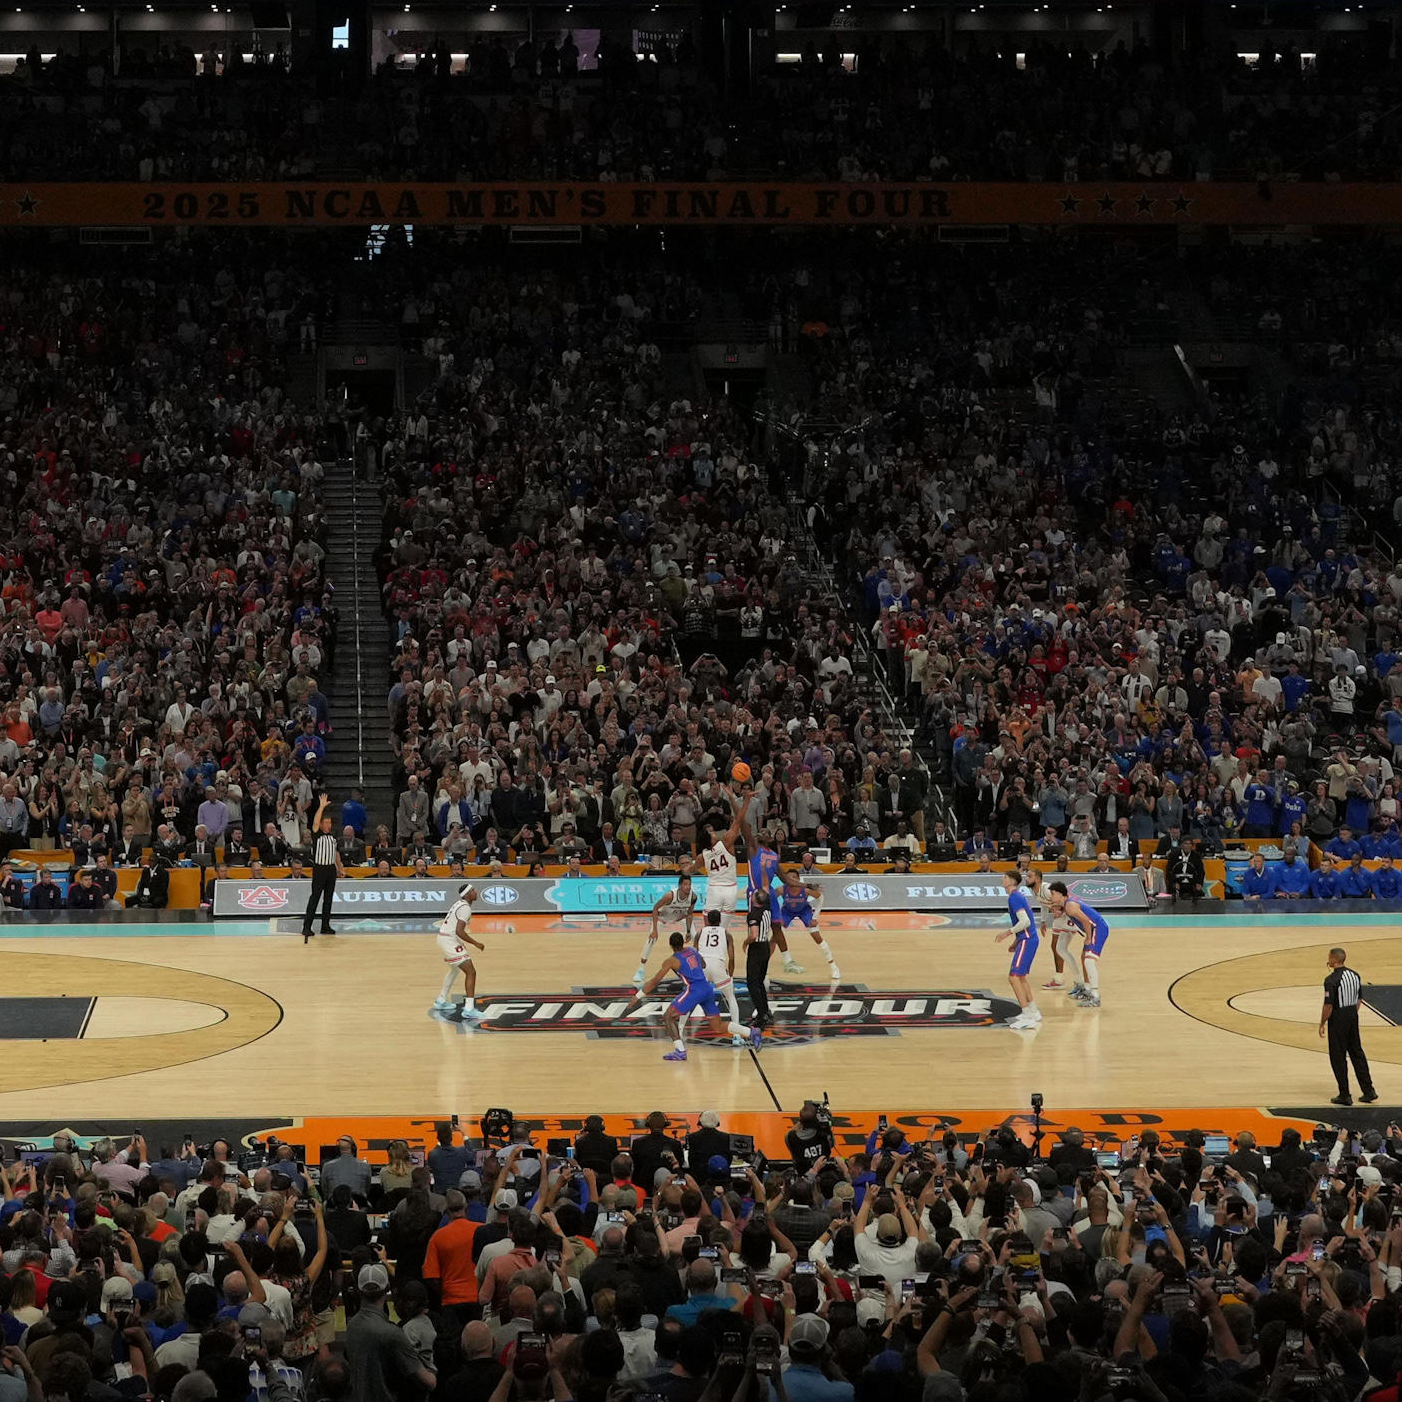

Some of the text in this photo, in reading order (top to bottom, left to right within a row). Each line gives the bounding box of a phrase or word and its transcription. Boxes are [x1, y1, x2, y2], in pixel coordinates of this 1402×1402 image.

[141, 192, 954, 219] 2025 NCAA MEN'S FINAL FOUR
[285, 813, 295, 822] 34
[710, 854, 729, 871] 44
[485, 888, 517, 901] SEC
[594, 884, 643, 893] AND
[846, 883, 880, 899] SEC
[706, 934, 719, 947] 13
